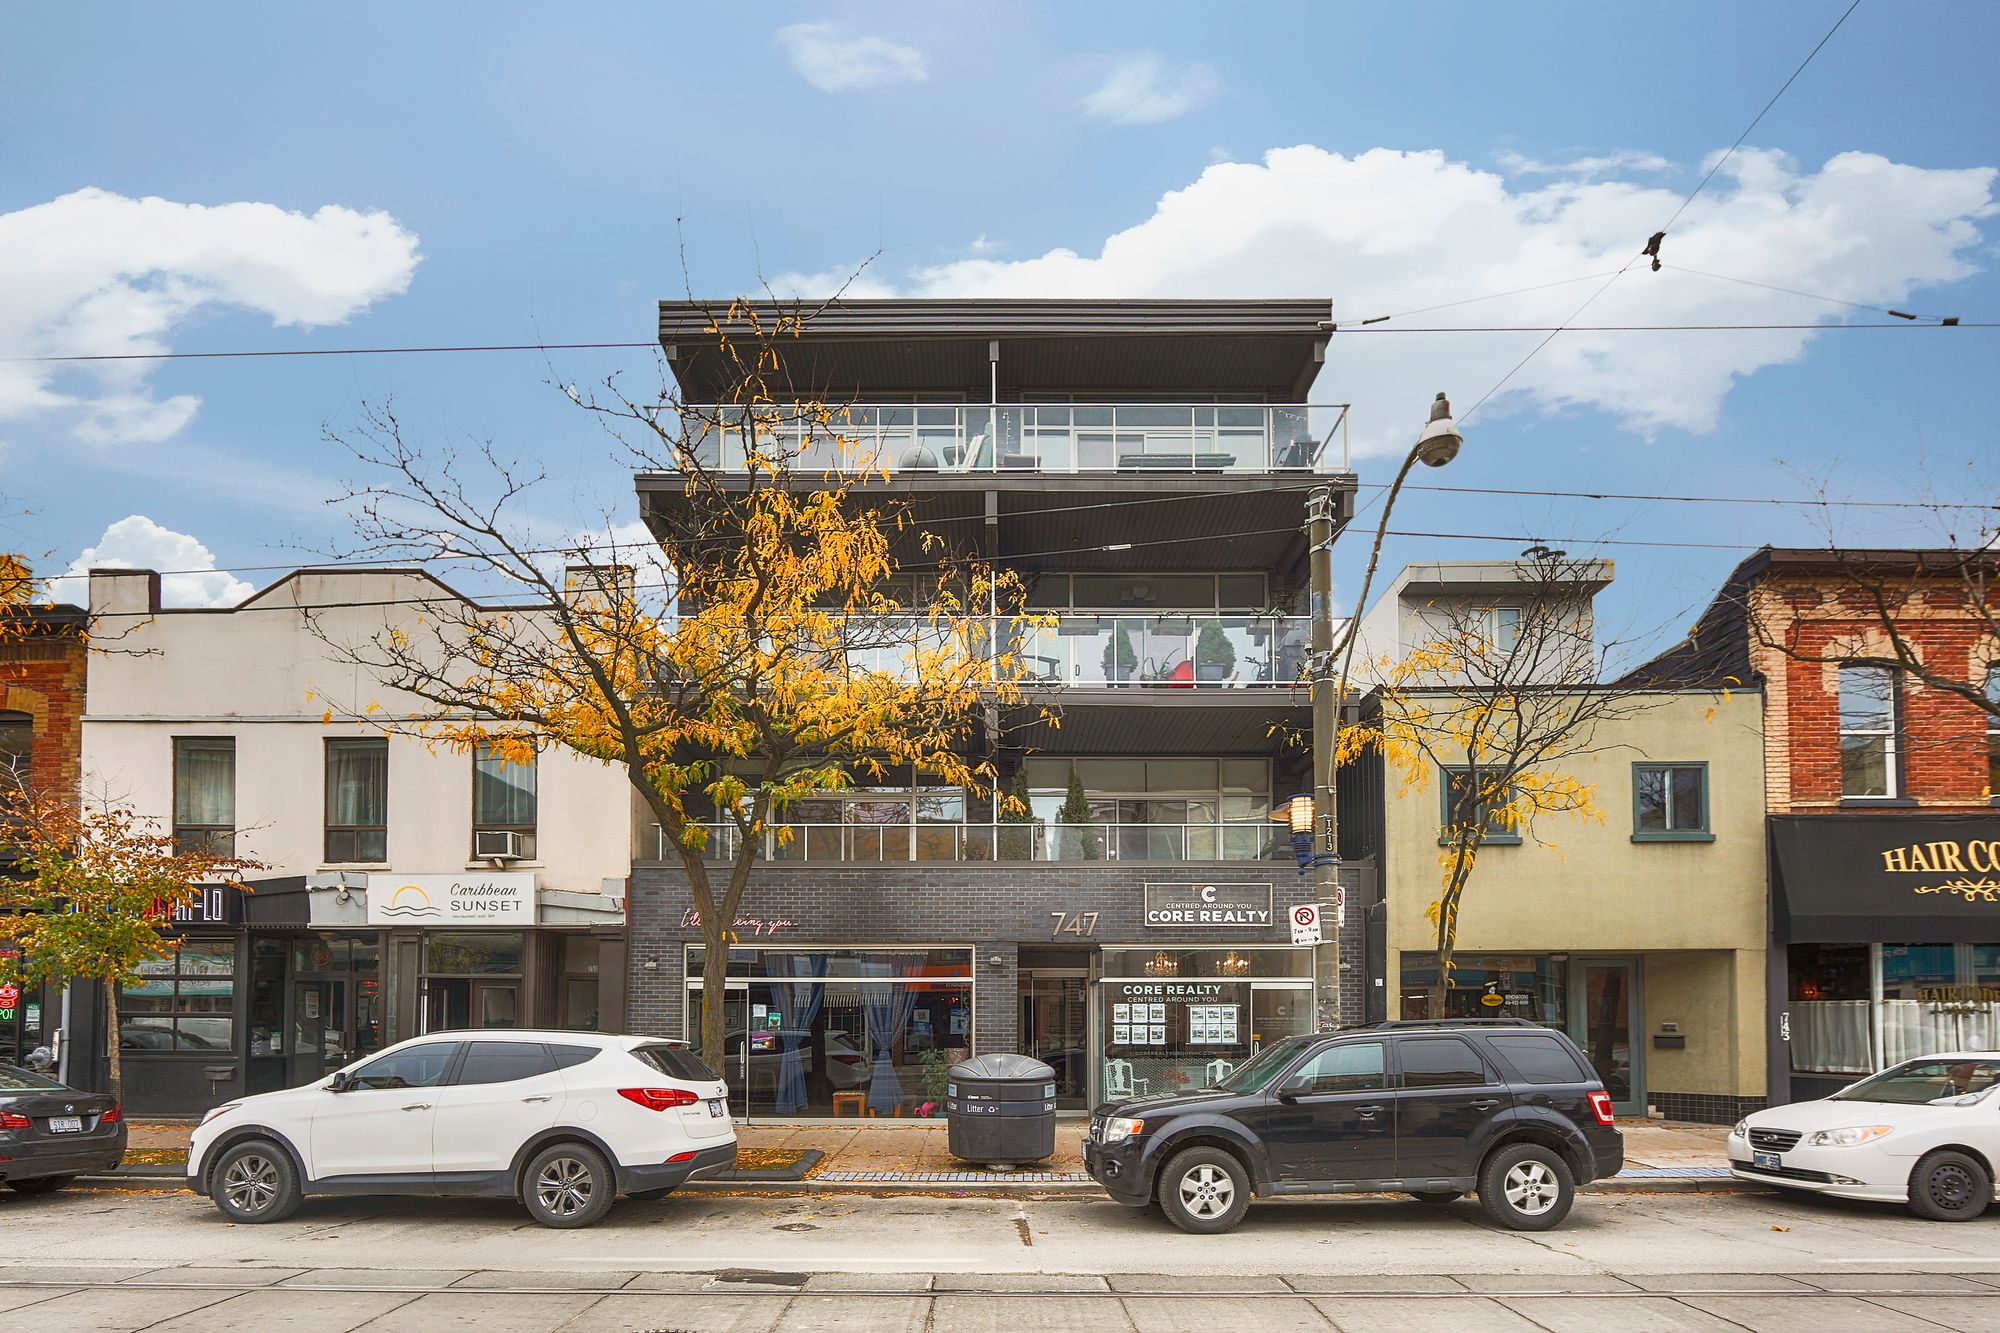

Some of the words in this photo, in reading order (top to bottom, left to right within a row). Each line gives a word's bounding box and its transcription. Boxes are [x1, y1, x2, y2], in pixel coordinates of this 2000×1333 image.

[1881, 840, 1968, 872] HAIR
[450, 883, 518, 896] Caribbean
[450, 900, 522, 911] SUNSET
[1148, 911, 1194, 922] CORE
[1200, 911, 1269, 922] REALTY
[1051, 912, 1099, 936] 747
[1123, 985, 1162, 995] CORE
[1166, 985, 1222, 995] REALTY
[1917, 985, 1956, 1001] HAIR
[1782, 1012, 1790, 1041] 743
[967, 1104, 984, 1113] Litter
